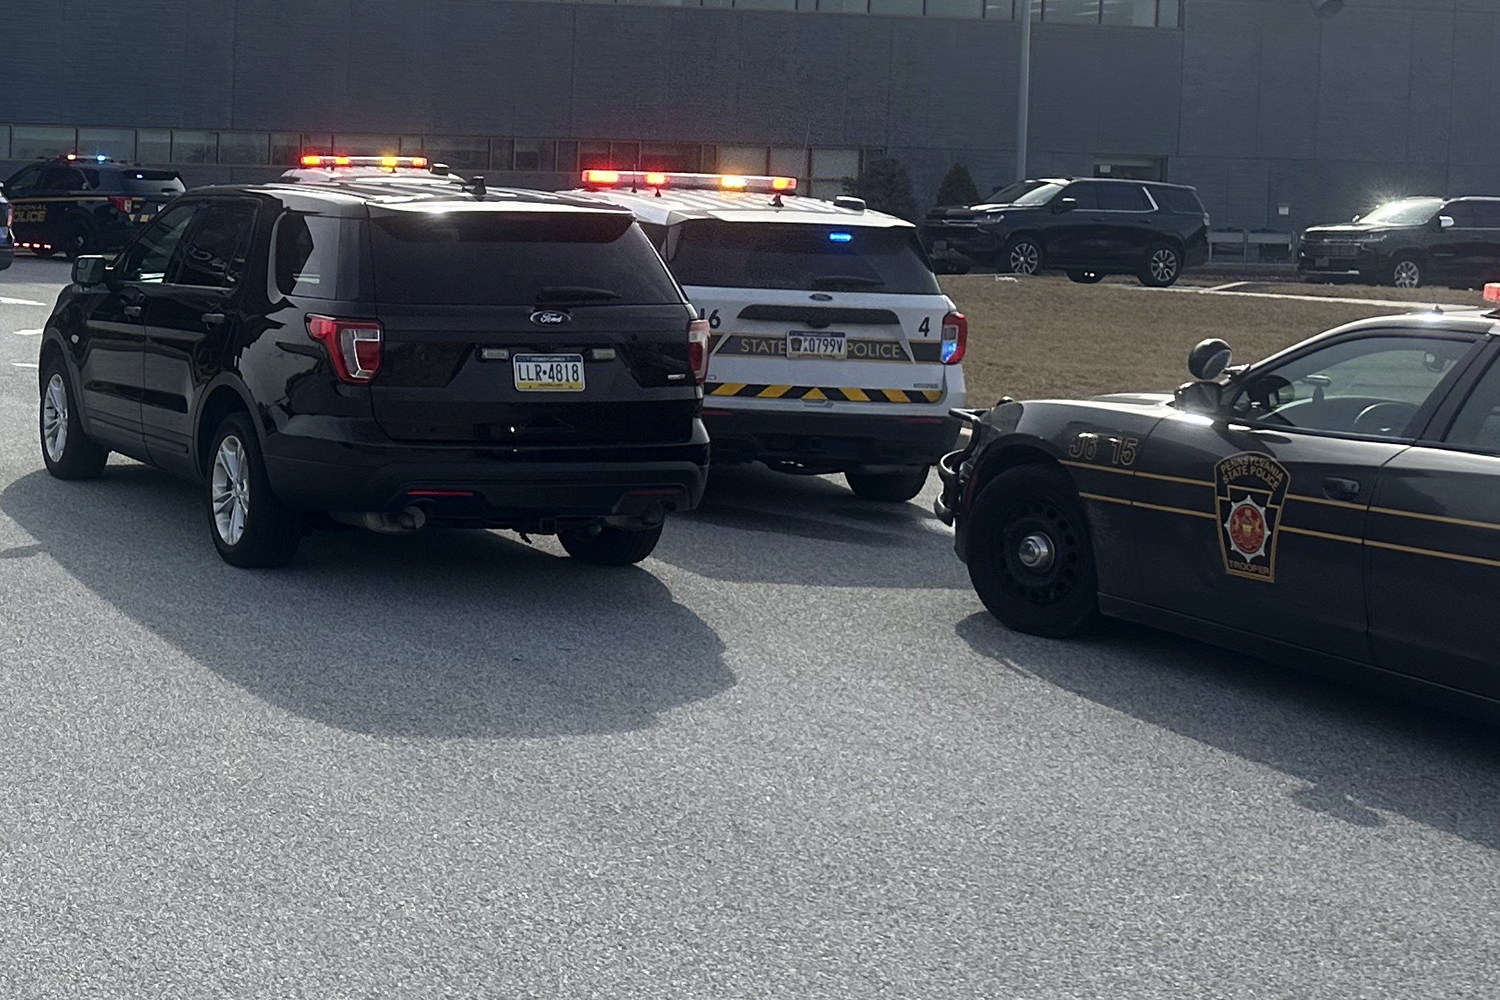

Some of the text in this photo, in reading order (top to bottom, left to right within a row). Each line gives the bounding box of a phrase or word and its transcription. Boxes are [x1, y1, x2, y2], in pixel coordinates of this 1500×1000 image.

[13, 211, 47, 222] OLICE
[540, 312, 563, 323] Ford
[918, 316, 931, 337] 4
[741, 338, 900, 358] STATE POLICE
[1068, 434, 1139, 466] J6 15
[1220, 456, 1283, 483] PENNSYLVANIA
[1222, 465, 1280, 491] STATE POLICE
[1228, 559, 1270, 575] TROOPER
